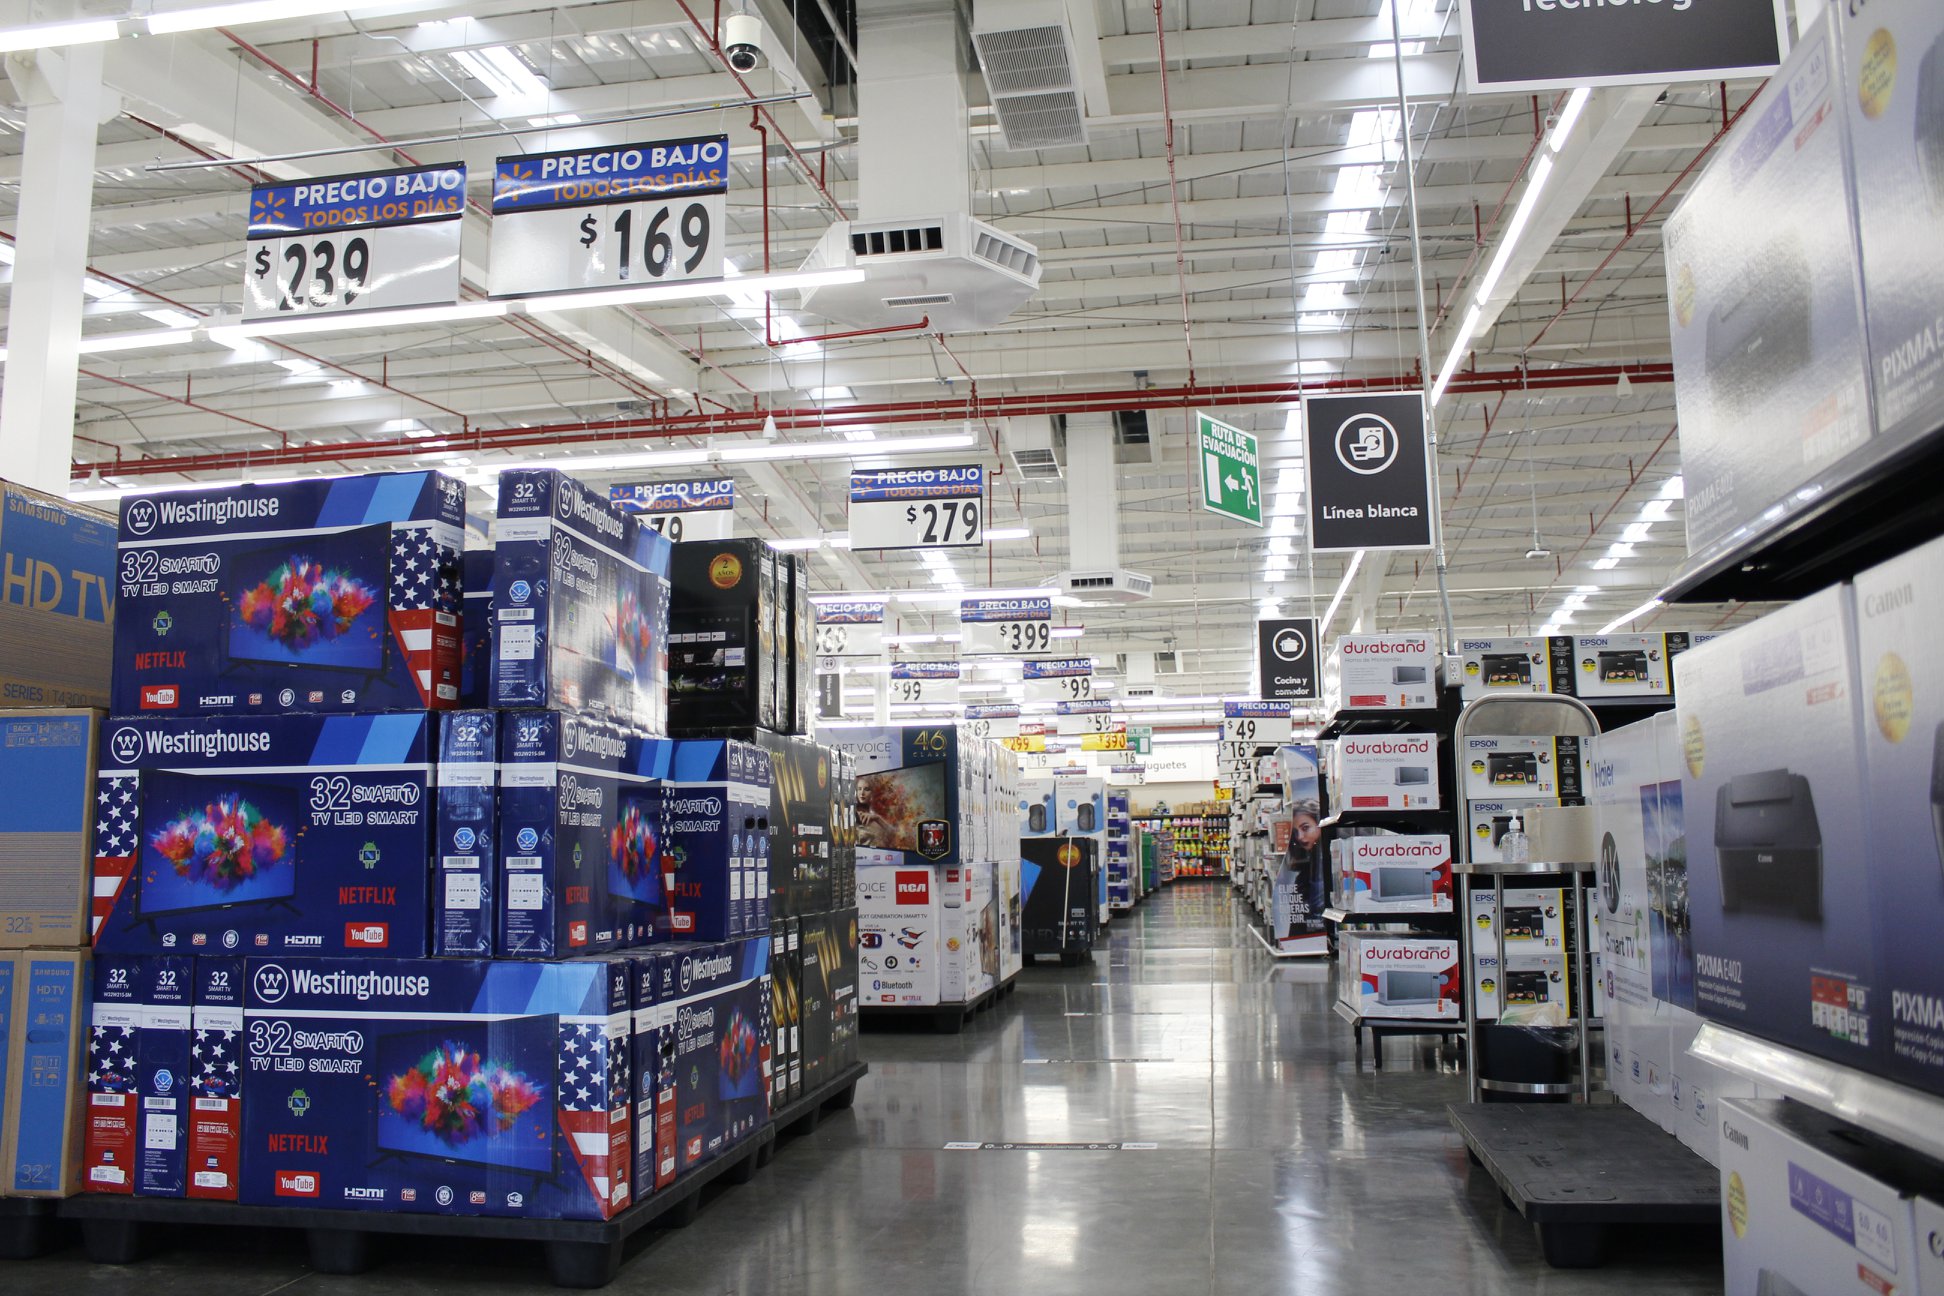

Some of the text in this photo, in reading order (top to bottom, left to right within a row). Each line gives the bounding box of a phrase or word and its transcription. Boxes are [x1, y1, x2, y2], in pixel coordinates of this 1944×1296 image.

[542, 142, 723, 179] PRECIO BAJO
[294, 169, 461, 207] PRECIO BAJO
[553, 167, 721, 200] TODOS LOS DÍAS
[303, 194, 458, 228] TODOS LOS DÍAS
[1210, 424, 1247, 448] RUTA DE
[1203, 437, 1256, 467] EVACUACIÓN
[878, 468, 980, 485] PRECIO BAJO
[514, 484, 534, 498] 32
[634, 480, 730, 498] PRECIO BAJO
[884, 487, 924, 498] TODOS
[928, 486, 949, 496] LOS
[10, 499, 67, 526] SAMSUNG
[160, 496, 279, 525] Westinghouse
[574, 490, 624, 540] Westinghouse
[1323, 504, 1418, 520] Línea blanca
[554, 532, 572, 571] 32
[122, 550, 159, 584] 32
[722, 560, 728, 569] 2
[3, 552, 116, 624] HD TV
[122, 579, 218, 598] TV LED SMART
[979, 600, 1049, 610] PRECIO BAJO
[1864, 583, 1914, 619] Canon
[1344, 640, 1426, 654] durabrand
[1464, 642, 1492, 650] EPSON
[136, 651, 186, 672] NETFLIX
[1036, 660, 1090, 670] PRECIO BAJO
[1274, 676, 1308, 686] Cocina y
[4, 683, 43, 702] SERIES
[146, 688, 175, 705] YouTube
[1275, 688, 1310, 696] comedor
[200, 696, 234, 706] HDMI
[1270, 702, 1290, 710] BAJO
[457, 726, 478, 742] 32
[520, 727, 539, 742] 32
[914, 729, 948, 751] 46
[146, 729, 270, 758] Westinghouse
[577, 726, 627, 760] Westinghouse
[856, 742, 892, 752] VOICE
[1346, 740, 1428, 754] durabrand
[1470, 740, 1498, 748] EPSON
[310, 776, 351, 811] 32
[560, 774, 577, 810] 32
[1474, 804, 1502, 812] EPSON
[312, 811, 418, 826] TV LED SMART
[675, 820, 721, 832] SMART
[1358, 844, 1442, 856] durabrand
[338, 886, 397, 906] NETFLIX
[566, 886, 590, 905] NETFLIX
[898, 884, 926, 892] RCA
[284, 935, 322, 946] HDMI
[351, 926, 384, 943] YouTube
[1366, 946, 1450, 960] durabrand
[110, 968, 127, 984] 32
[692, 955, 732, 981] Westinghouse
[1696, 953, 1742, 984] PIXMA E402
[160, 970, 176, 986] 32
[212, 971, 228, 986] 32
[292, 969, 430, 1000] Westinghouse
[882, 980, 912, 990] Bluetooth
[36, 985, 66, 995] HD TV
[1892, 990, 1944, 1030] PIXMA
[678, 1006, 692, 1040] 32
[250, 1020, 292, 1056] 32
[250, 1056, 362, 1074] TV LED SMART
[1722, 1120, 1749, 1150] Canon
[268, 1134, 328, 1155] NETFLIX
[281, 1175, 314, 1192] YouTube
[344, 1187, 384, 1198] HDMI
